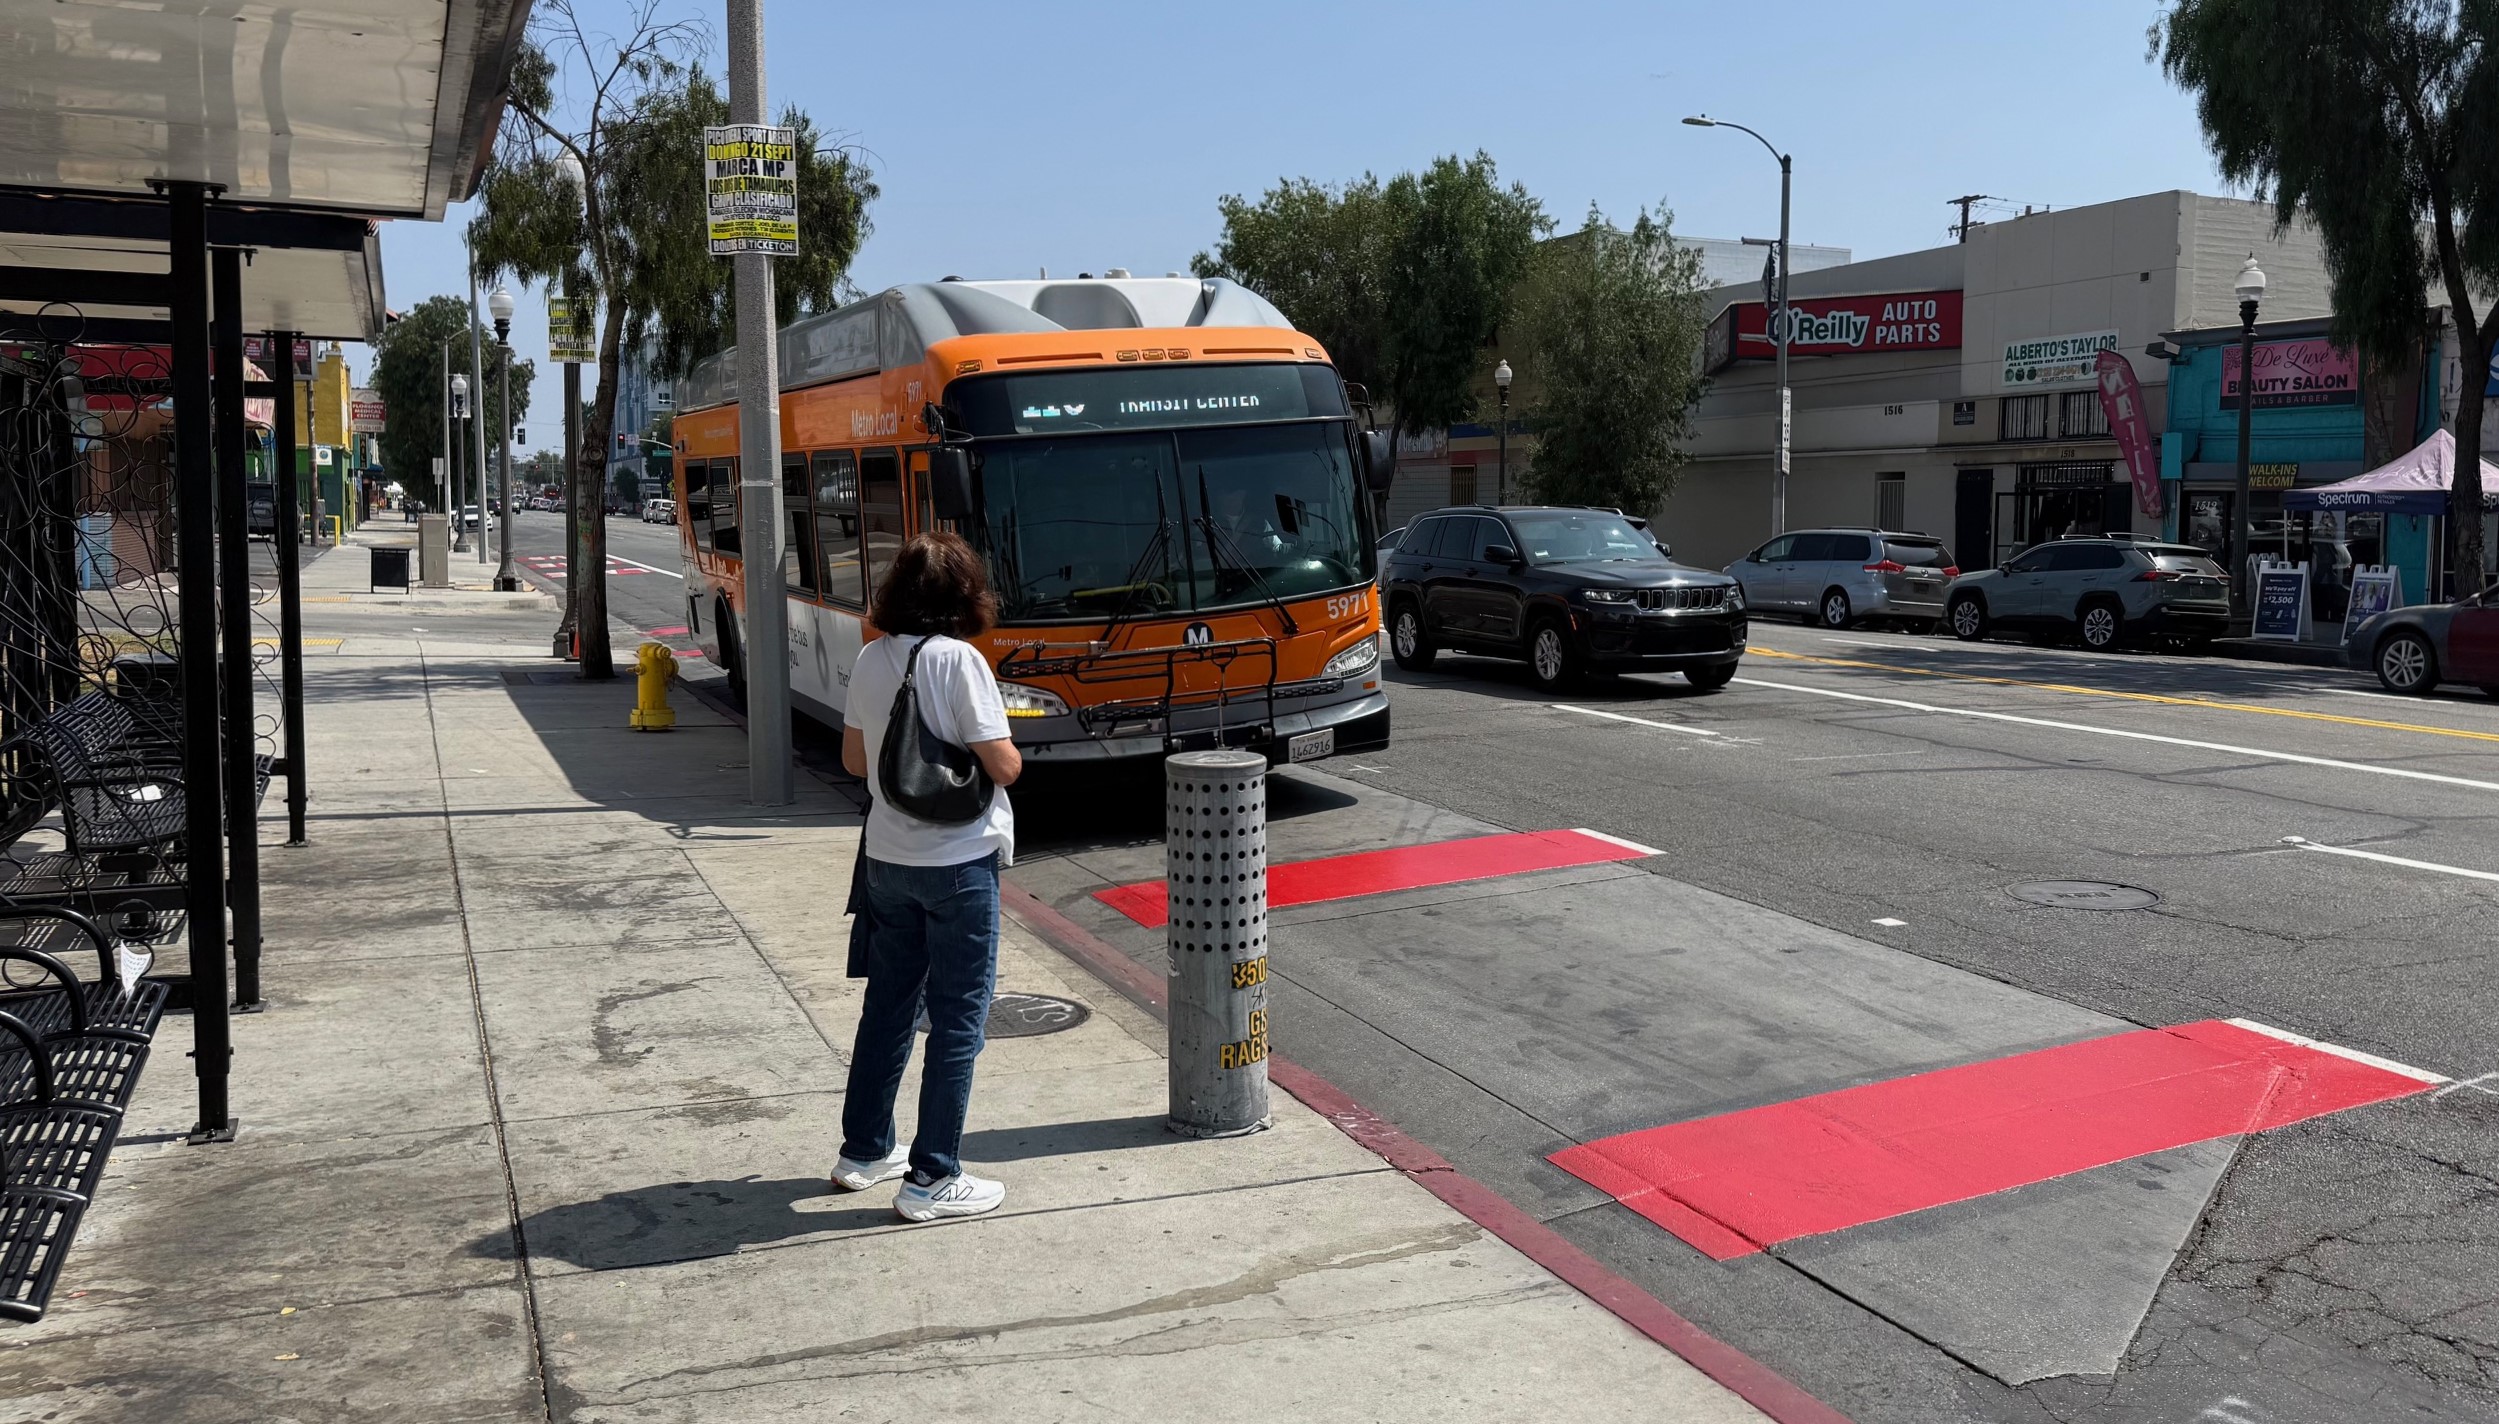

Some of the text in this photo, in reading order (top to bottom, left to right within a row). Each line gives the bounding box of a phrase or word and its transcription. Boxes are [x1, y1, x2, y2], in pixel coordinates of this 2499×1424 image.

[742, 128, 766, 142] SPORT
[768, 130, 791, 145] ARENA
[708, 142, 792, 160] DOMINGO 21 SEPT
[716, 158, 785, 178] MARCA MP
[709, 179, 724, 193] LOS
[743, 177, 793, 193] TAMAULIPAS
[735, 192, 792, 208] CLASIFICADO
[1882, 300, 1937, 321] AUTO
[1768, 309, 1869, 345] O'Reilly
[1876, 322, 1941, 344] PARTS
[2005, 335, 2117, 361] ALBERTO'S TAYLOR
[2252, 346, 2281, 368] De
[2228, 374, 2348, 393] BAUTY SALON
[2286, 395, 2328, 403] BARBER
[1884, 405, 1903, 416] 1516
[852, 404, 897, 437] Metro Local
[2061, 449, 2075, 458] 1518
[2249, 464, 2298, 475] WALK-INS
[2318, 492, 2370, 507] Spectrum
[2483, 493, 2499, 509] Sp
[1327, 592, 1368, 619] 5971
[1188, 627, 1208, 645] M
